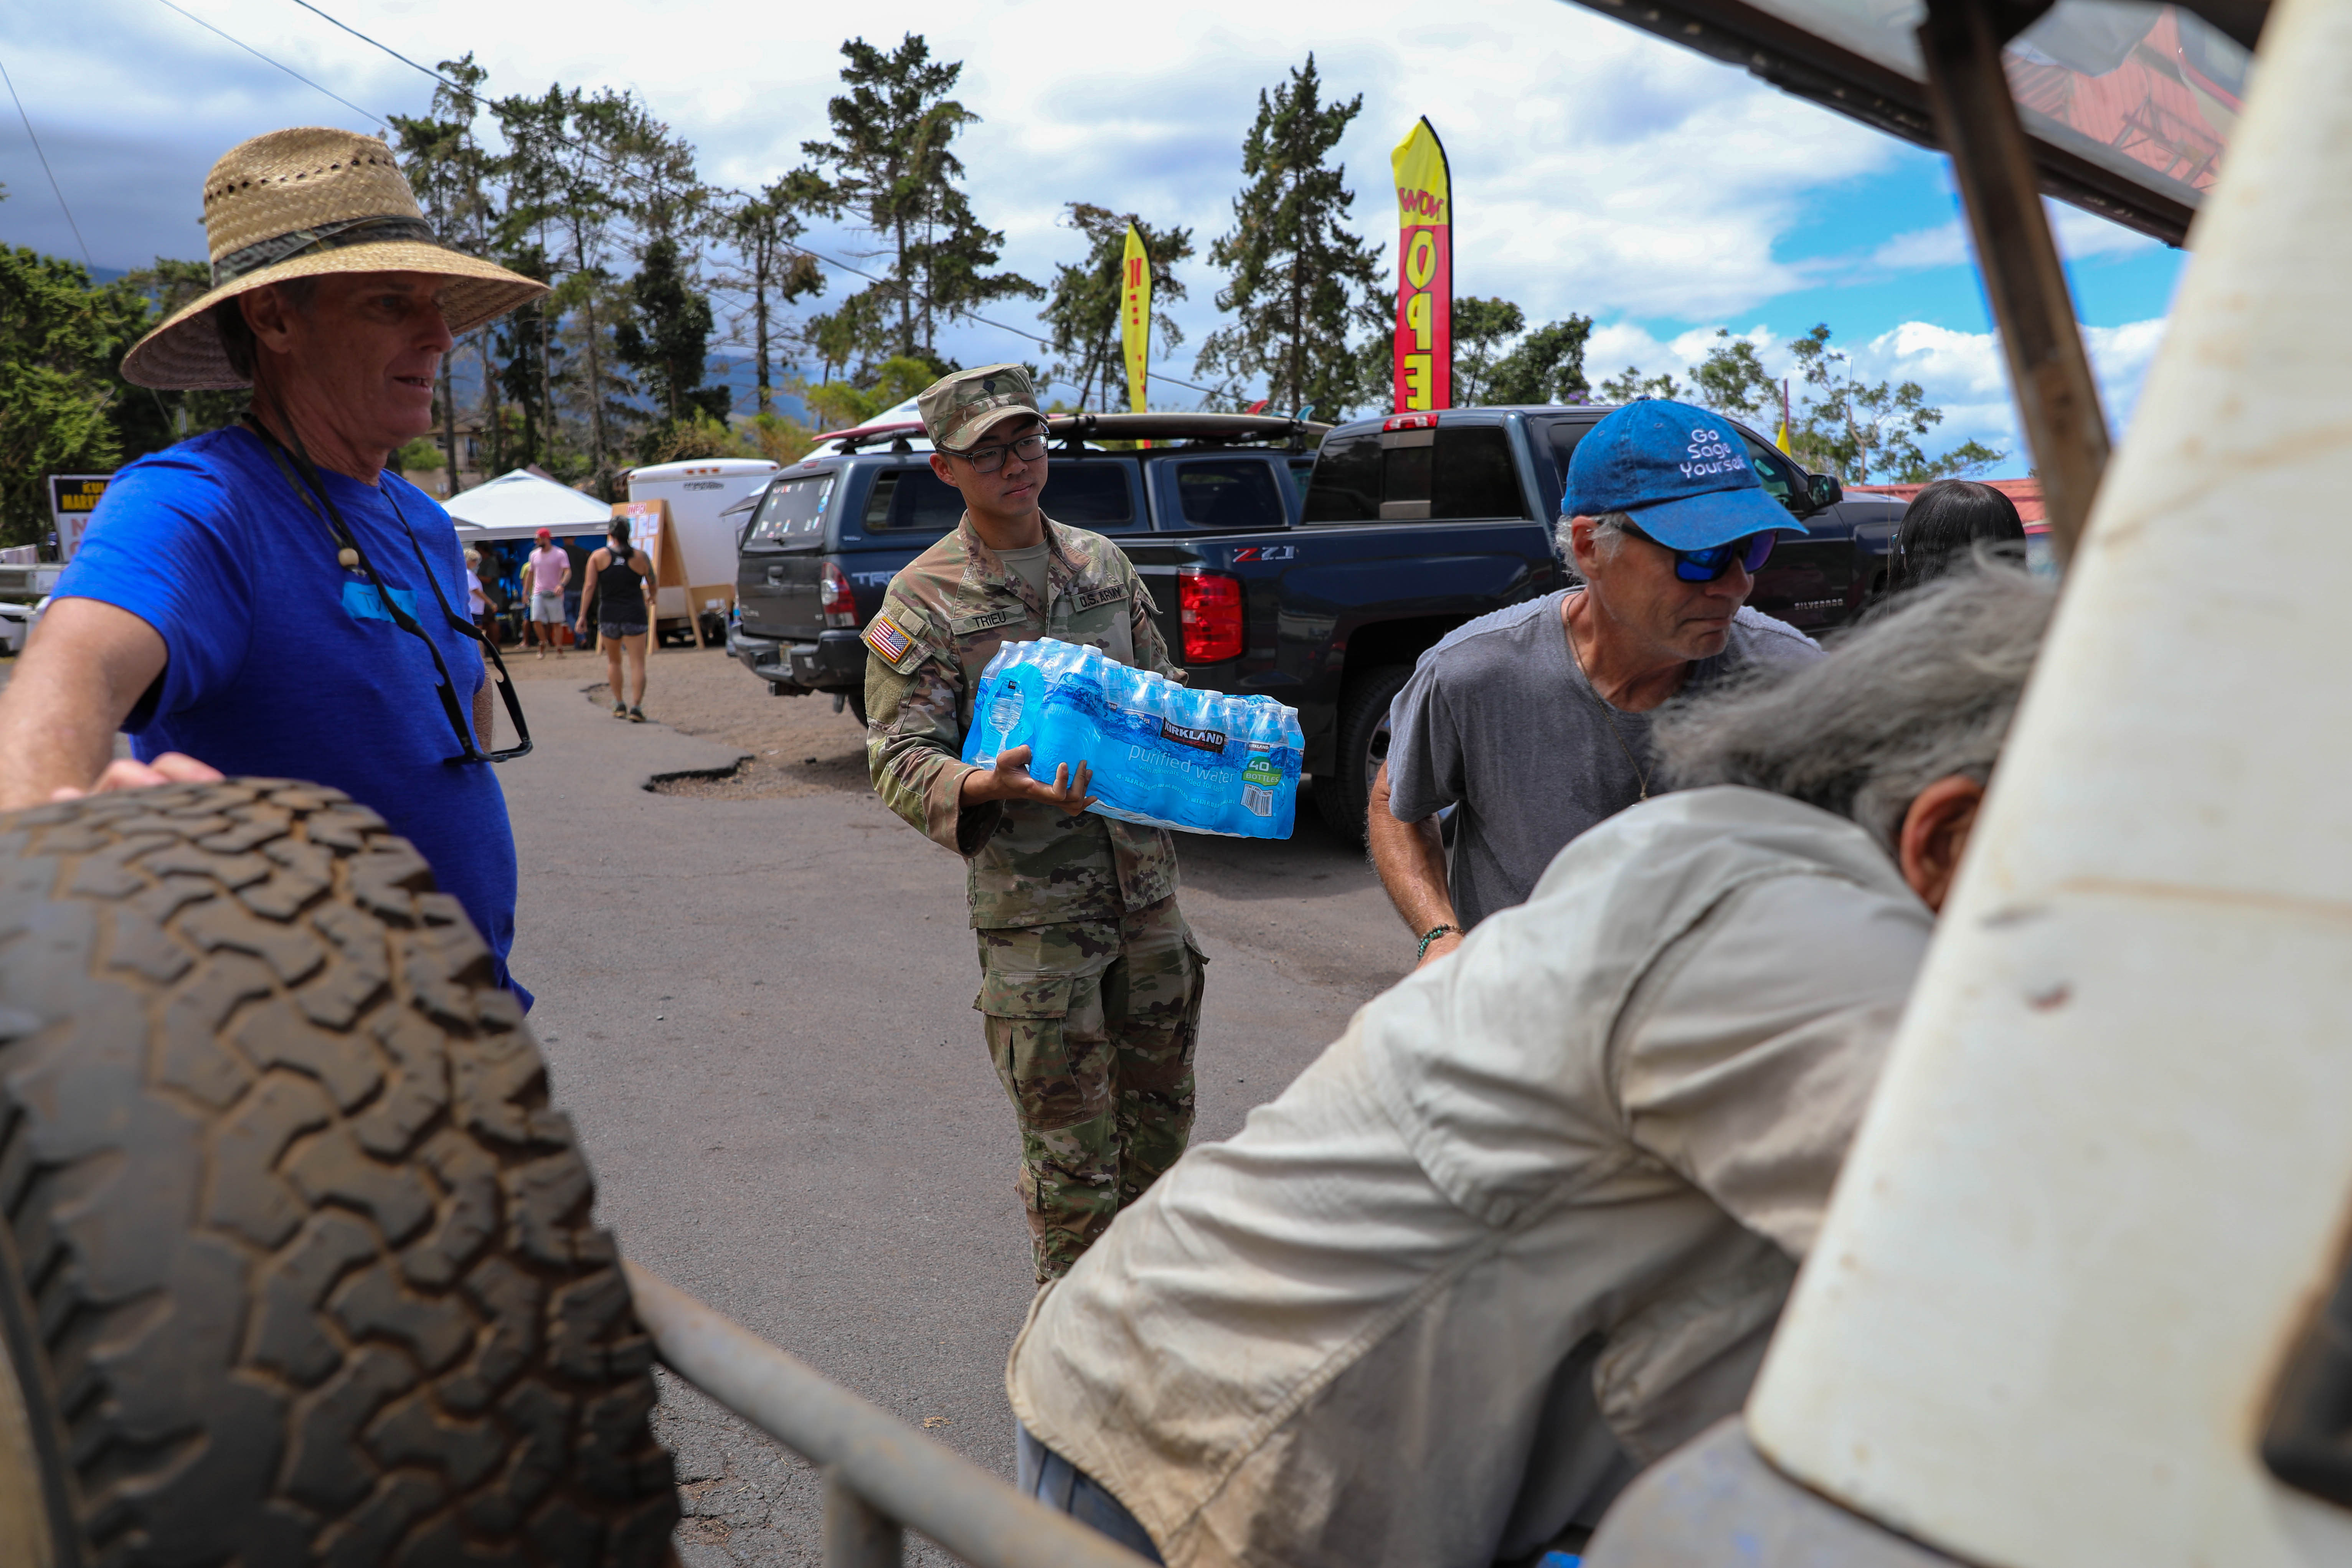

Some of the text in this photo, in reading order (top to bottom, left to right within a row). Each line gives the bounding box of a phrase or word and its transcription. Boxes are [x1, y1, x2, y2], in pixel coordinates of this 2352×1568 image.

[1691, 429, 1719, 442] Go
[1687, 442, 1731, 459] Sage
[1679, 454, 1746, 479] Yourself
[82, 482, 107, 494] KUL
[627, 504, 646, 514] INFO
[71, 518, 88, 536] N
[1232, 545, 1295, 563] Z71
[1079, 586, 1122, 608] U.S. ARMY
[1794, 598, 1843, 610] SILVERADO
[972, 611, 1007, 628] TRIEU
[1164, 721, 1223, 745] KIRKLAND
[1128, 745, 1235, 784] purified water
[1249, 761, 1270, 772] 40
[1139, 764, 1152, 774] with
[1152, 768, 1179, 777] minerals
[1181, 774, 1201, 787] added
[1203, 781, 1212, 790] for
[1246, 773, 1279, 783] BOTTLES
